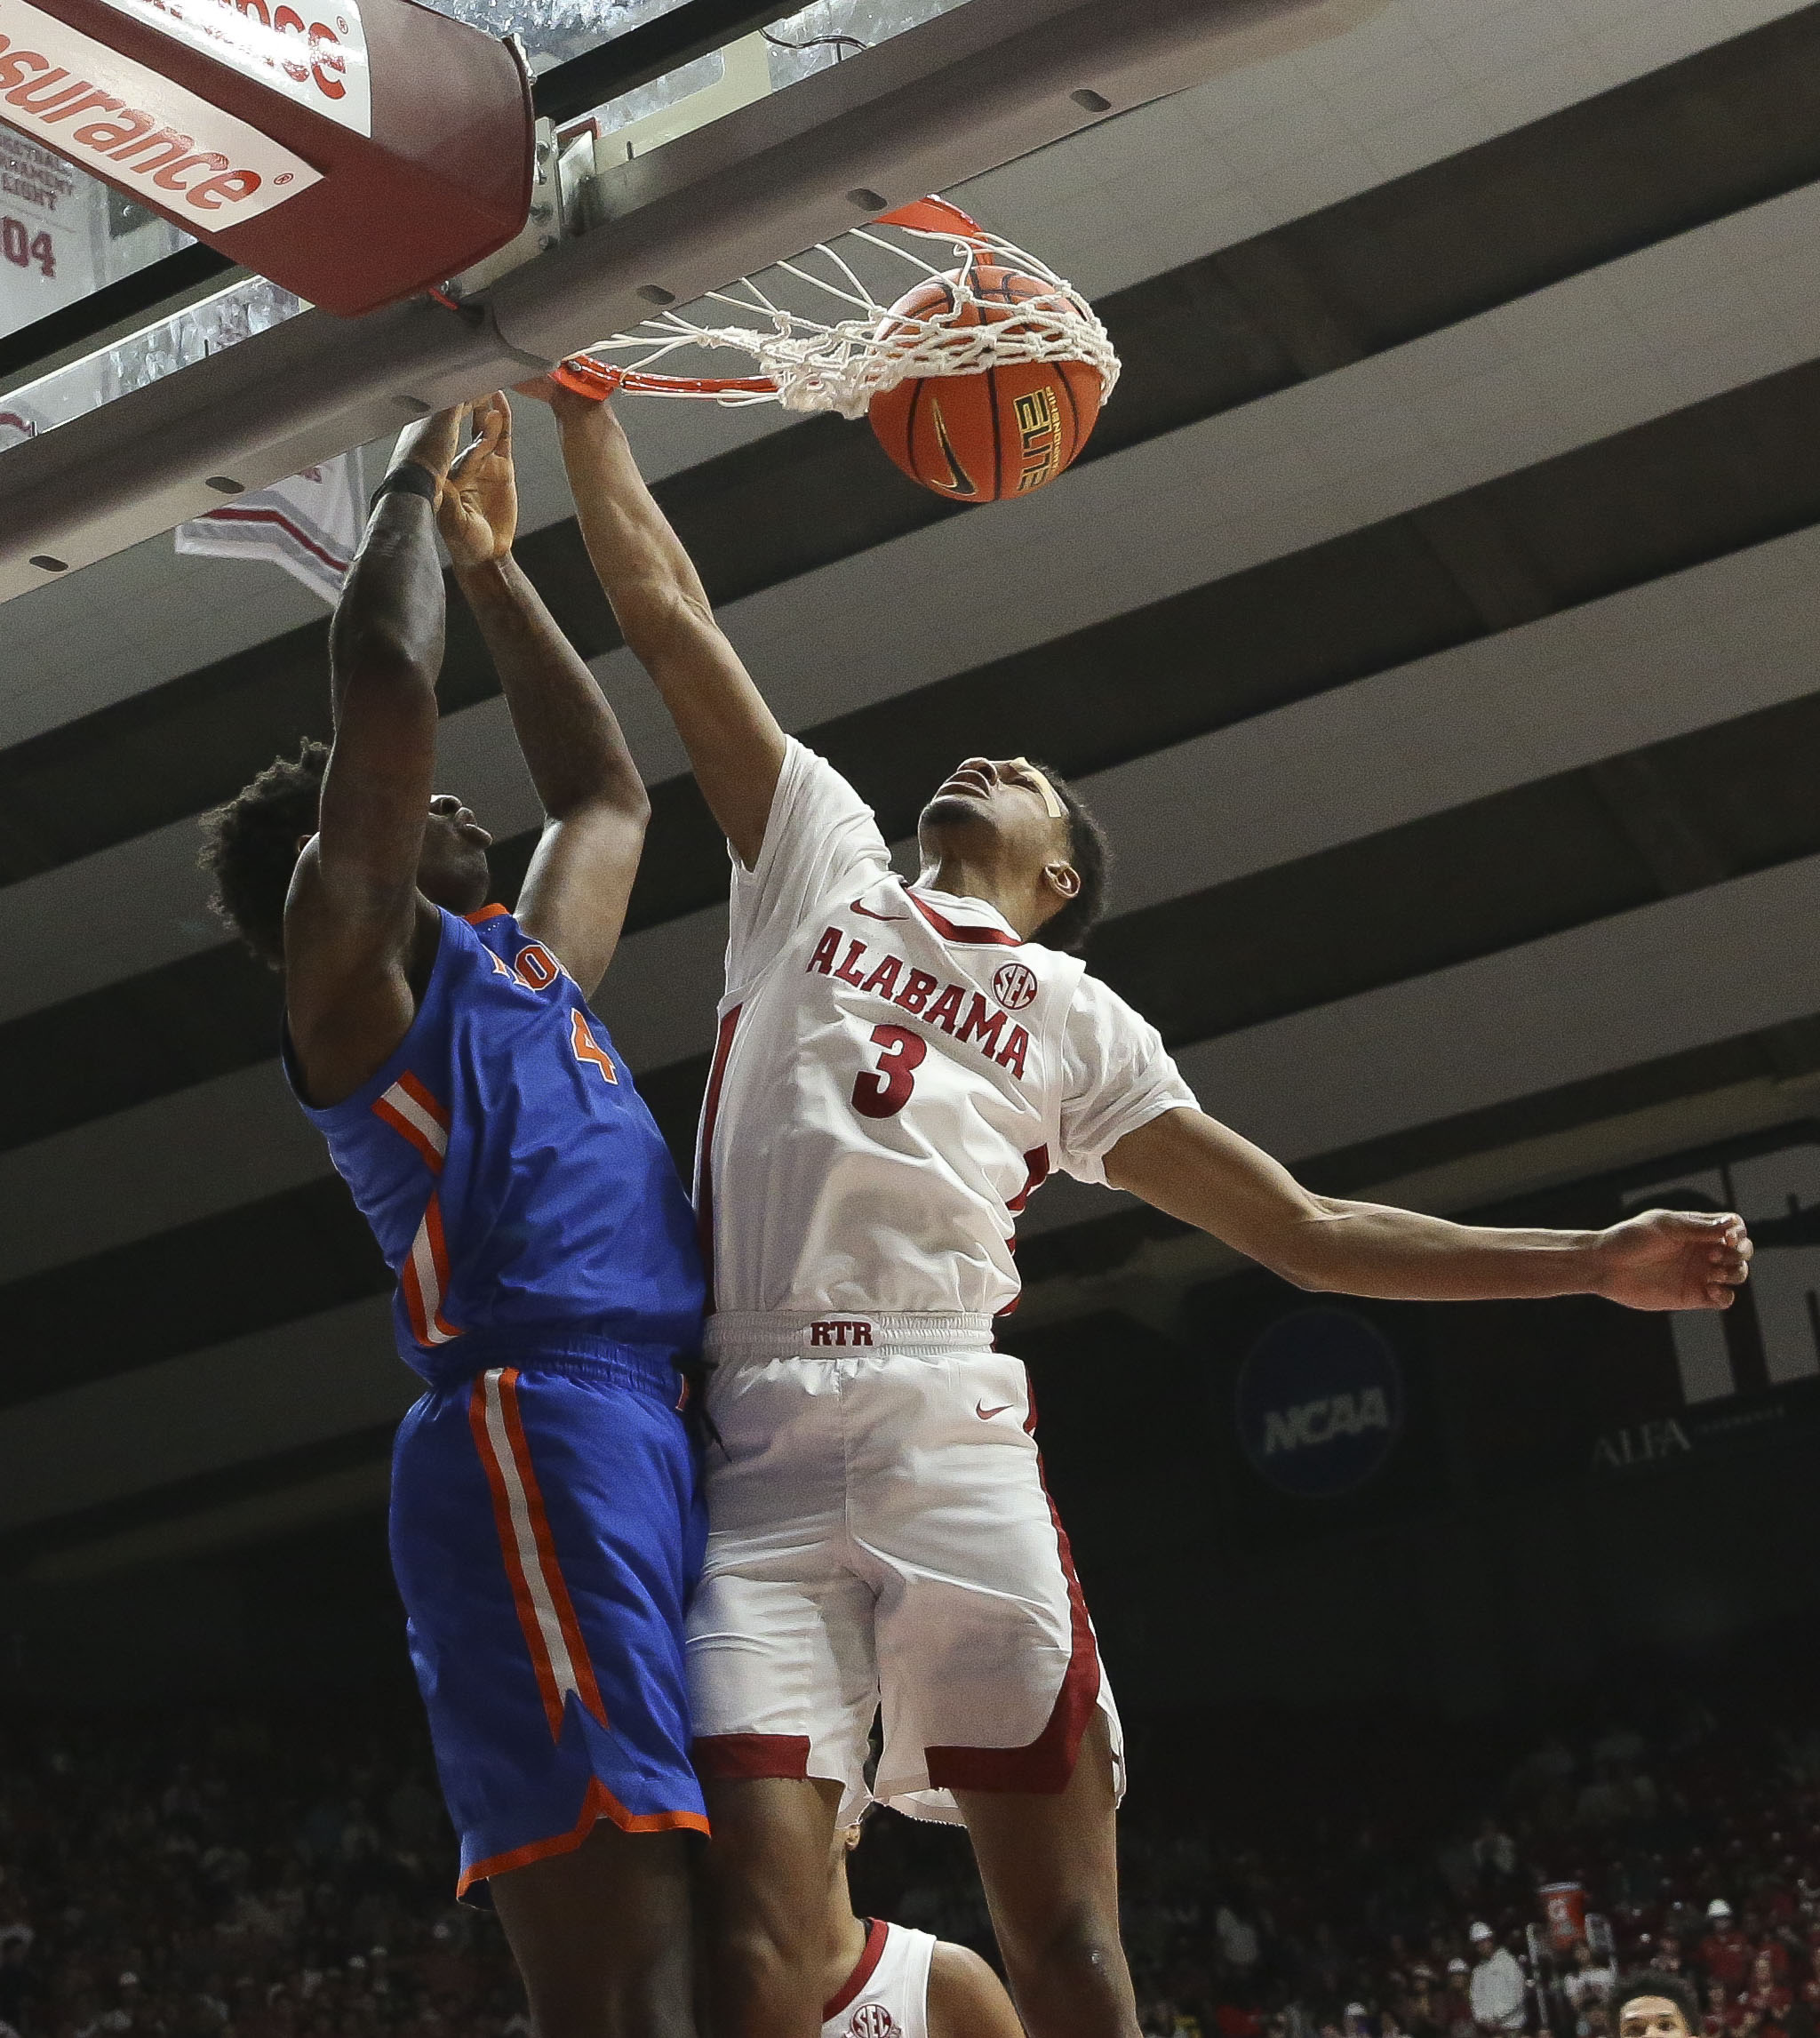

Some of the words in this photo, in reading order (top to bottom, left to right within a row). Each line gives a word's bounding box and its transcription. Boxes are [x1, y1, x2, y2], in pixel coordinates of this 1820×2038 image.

[0, 34, 262, 210] surance
[1013, 388, 1053, 492] ELITE
[806, 926, 1030, 1082] ALABAMA
[994, 963, 1037, 1010] SEC
[571, 1007, 619, 1085] 4
[851, 1024, 928, 1118] 3
[810, 1321, 873, 1346] RTR
[1265, 1387, 1388, 1454] NCAA
[1593, 1417, 1692, 1470] ALFA
[853, 2004, 891, 2038] SEC
